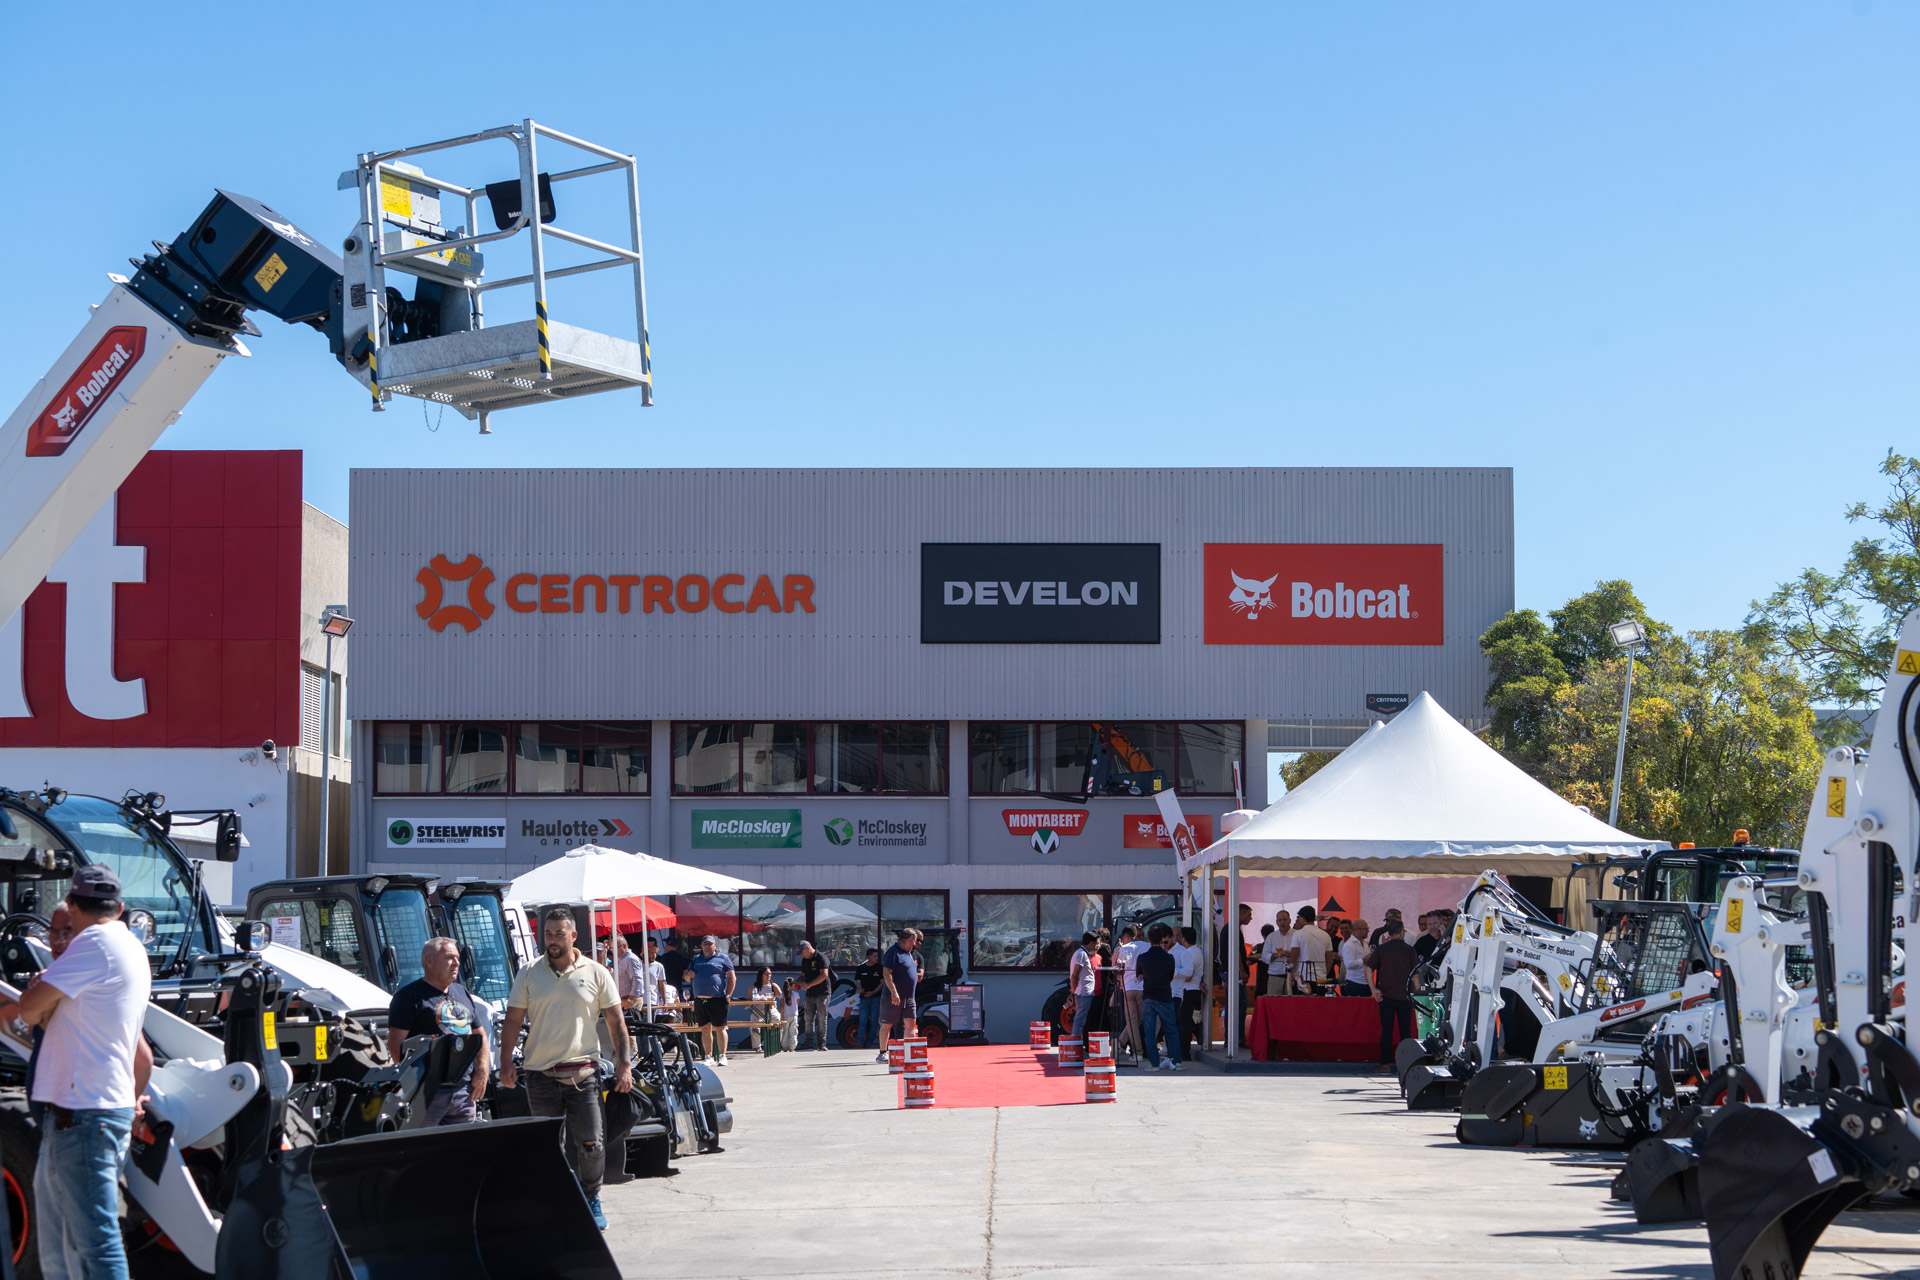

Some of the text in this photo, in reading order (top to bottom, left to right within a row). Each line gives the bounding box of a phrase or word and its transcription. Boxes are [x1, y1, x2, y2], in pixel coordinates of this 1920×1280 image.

[505, 574, 816, 614] CENTROCAR
[944, 581, 1138, 606] DEVELON
[1009, 814, 1081, 828] MONTABERT
[416, 825, 506, 838] STEELWRIST
[521, 819, 599, 837] Haulotte
[702, 819, 791, 838] McCloskey
[858, 819, 927, 837] McCloskey
[540, 838, 598, 846] GROUP
[858, 836, 927, 847] Environmental
[1523, 950, 1541, 960] Bobcat
[1556, 946, 1575, 957] Bobcat
[1618, 1005, 1637, 1016] Bobcat
